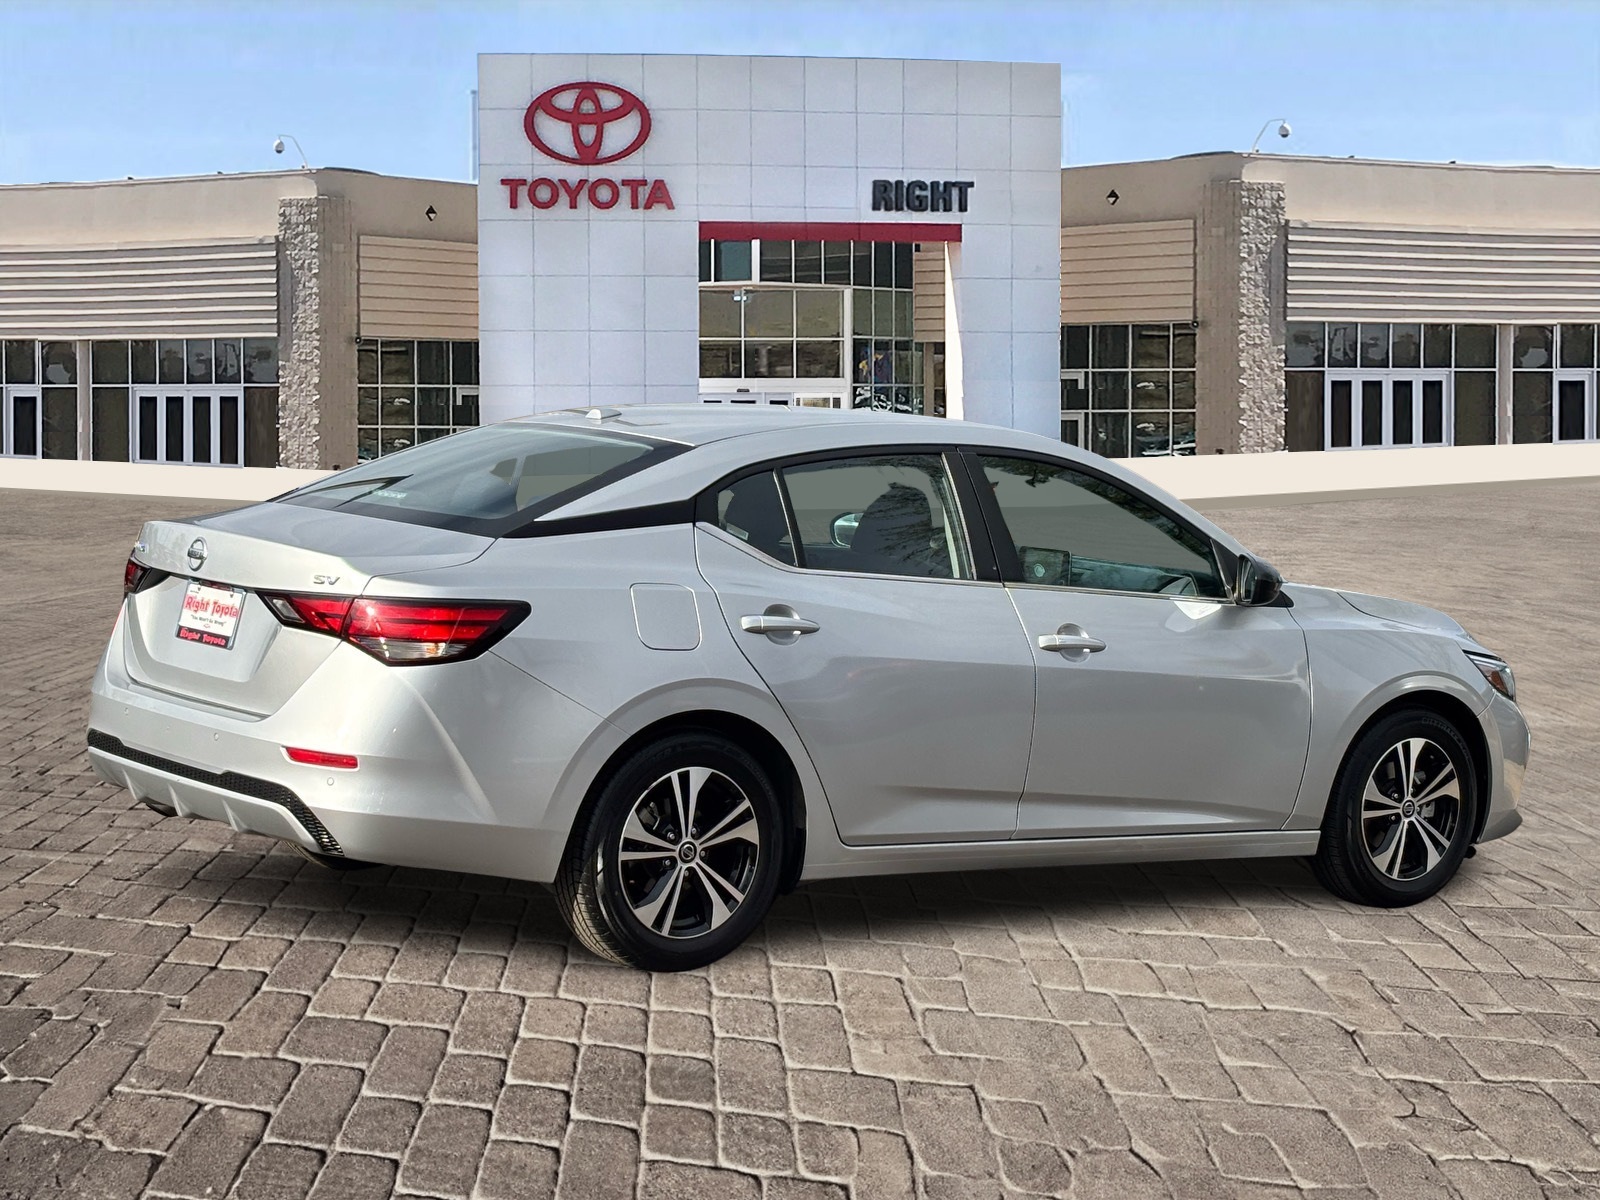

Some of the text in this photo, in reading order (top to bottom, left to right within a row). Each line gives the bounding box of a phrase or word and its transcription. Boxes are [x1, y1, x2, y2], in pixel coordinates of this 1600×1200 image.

[500, 178, 676, 211] TOYOTA
[871, 178, 975, 213] RIGHT
[313, 574, 341, 586] SV
[185, 595, 239, 618] Right Toyota
[180, 627, 226, 646] Right Toyota
